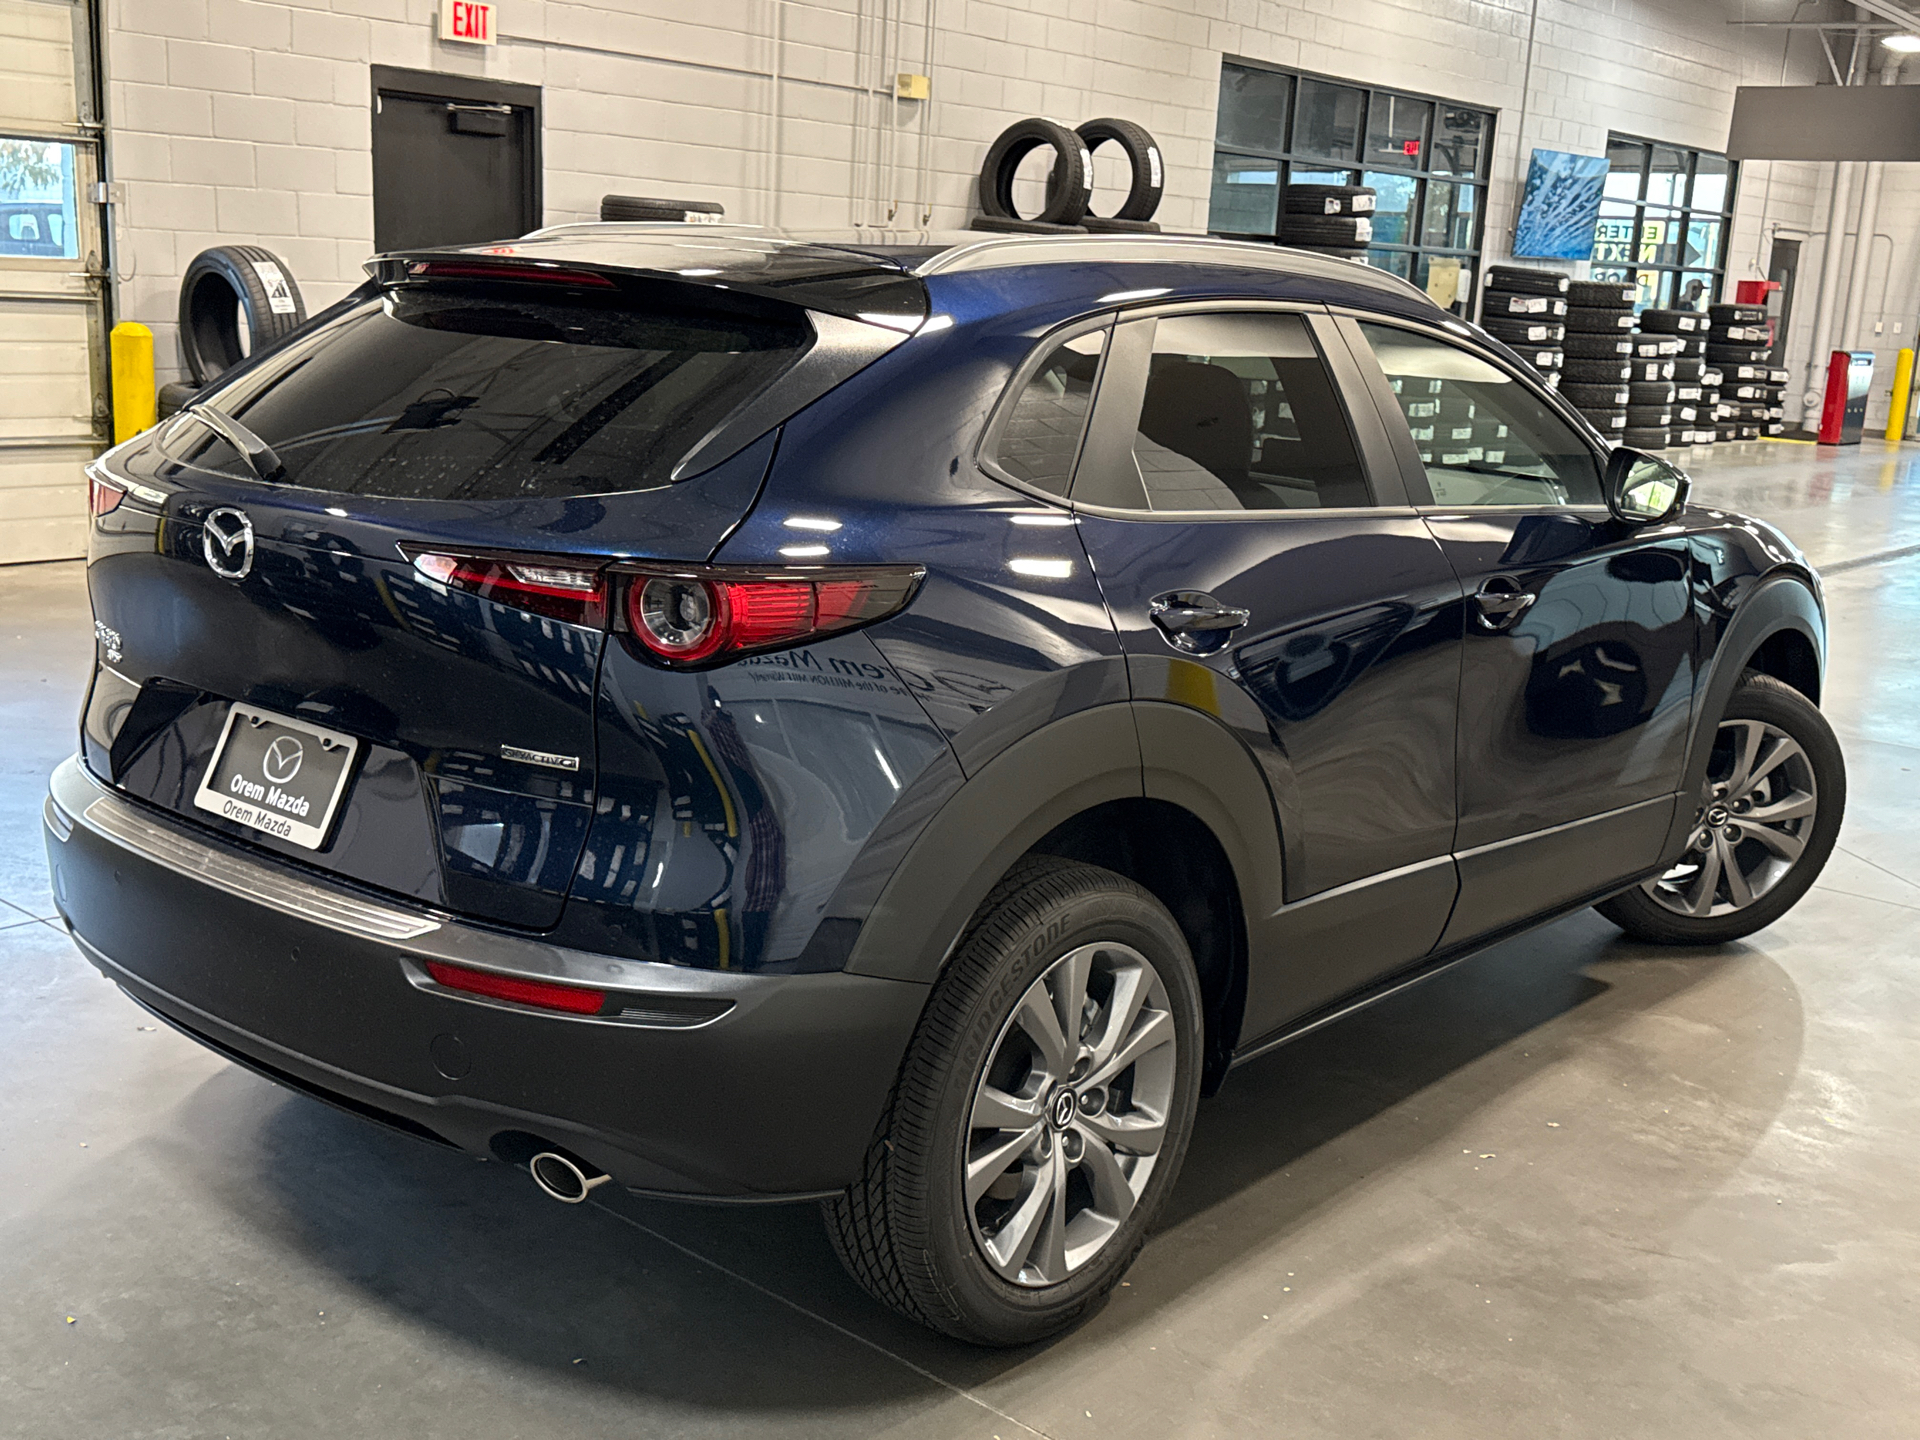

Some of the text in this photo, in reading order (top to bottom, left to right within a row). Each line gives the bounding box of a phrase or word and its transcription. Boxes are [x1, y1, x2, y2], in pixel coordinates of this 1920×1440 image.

[453, 1, 489, 40] EXIT
[230, 774, 310, 817] Orem Mazda
[223, 800, 292, 837] Orem Mazda
